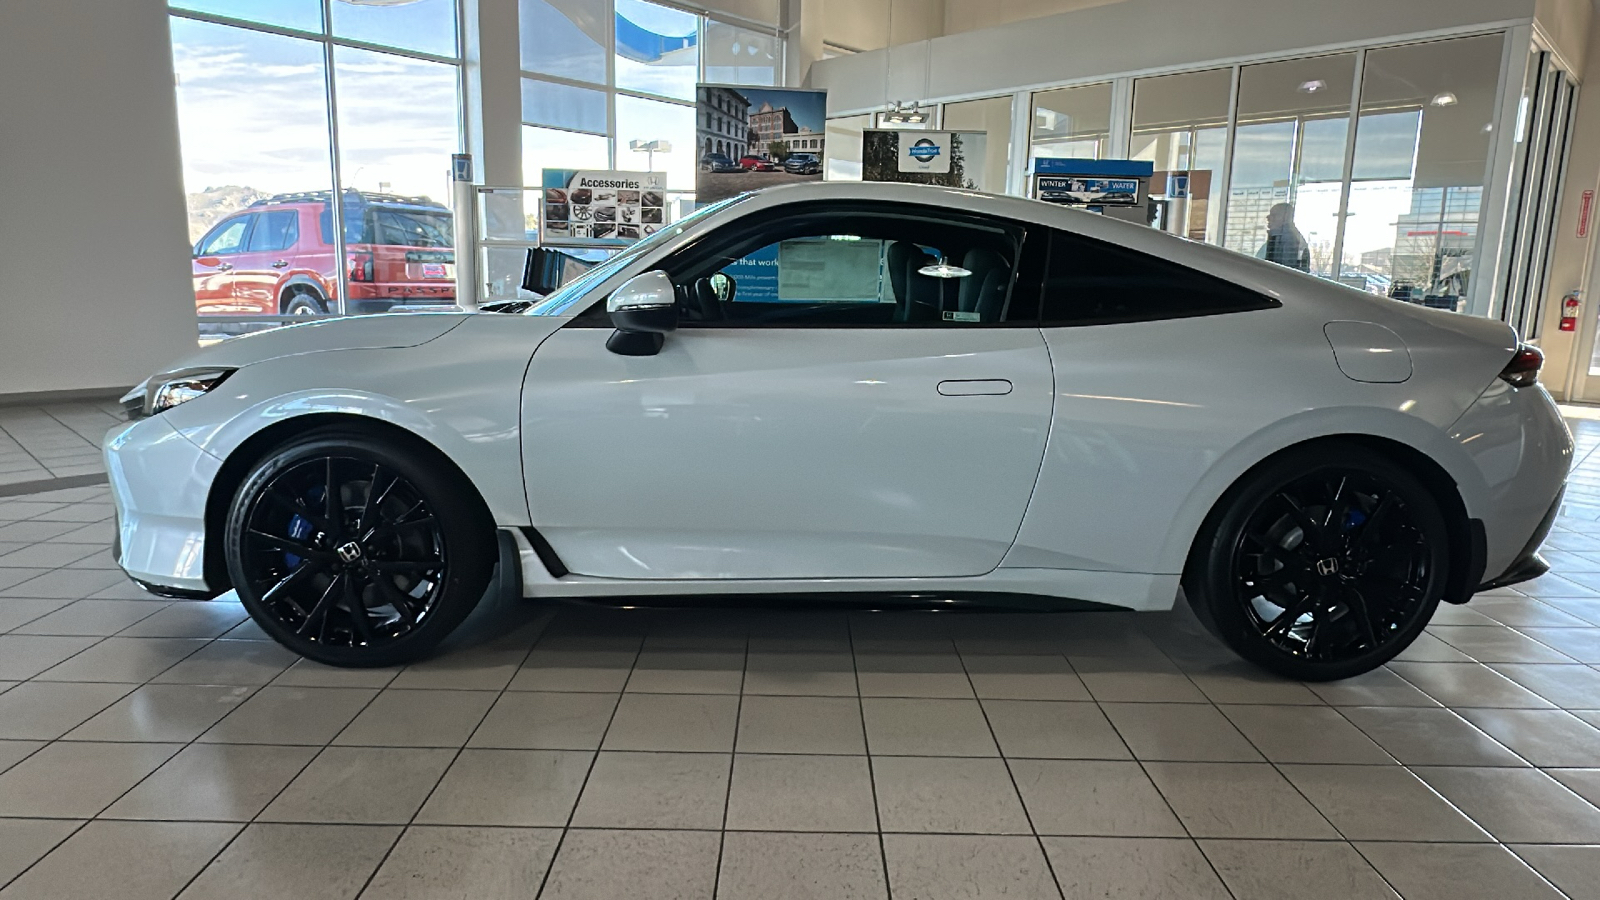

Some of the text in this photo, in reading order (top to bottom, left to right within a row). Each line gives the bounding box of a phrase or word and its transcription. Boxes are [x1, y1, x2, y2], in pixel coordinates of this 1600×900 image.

[580, 177, 640, 189] Accessories
[1041, 180, 1135, 190] WINTER WATER
[739, 257, 756, 266] that
